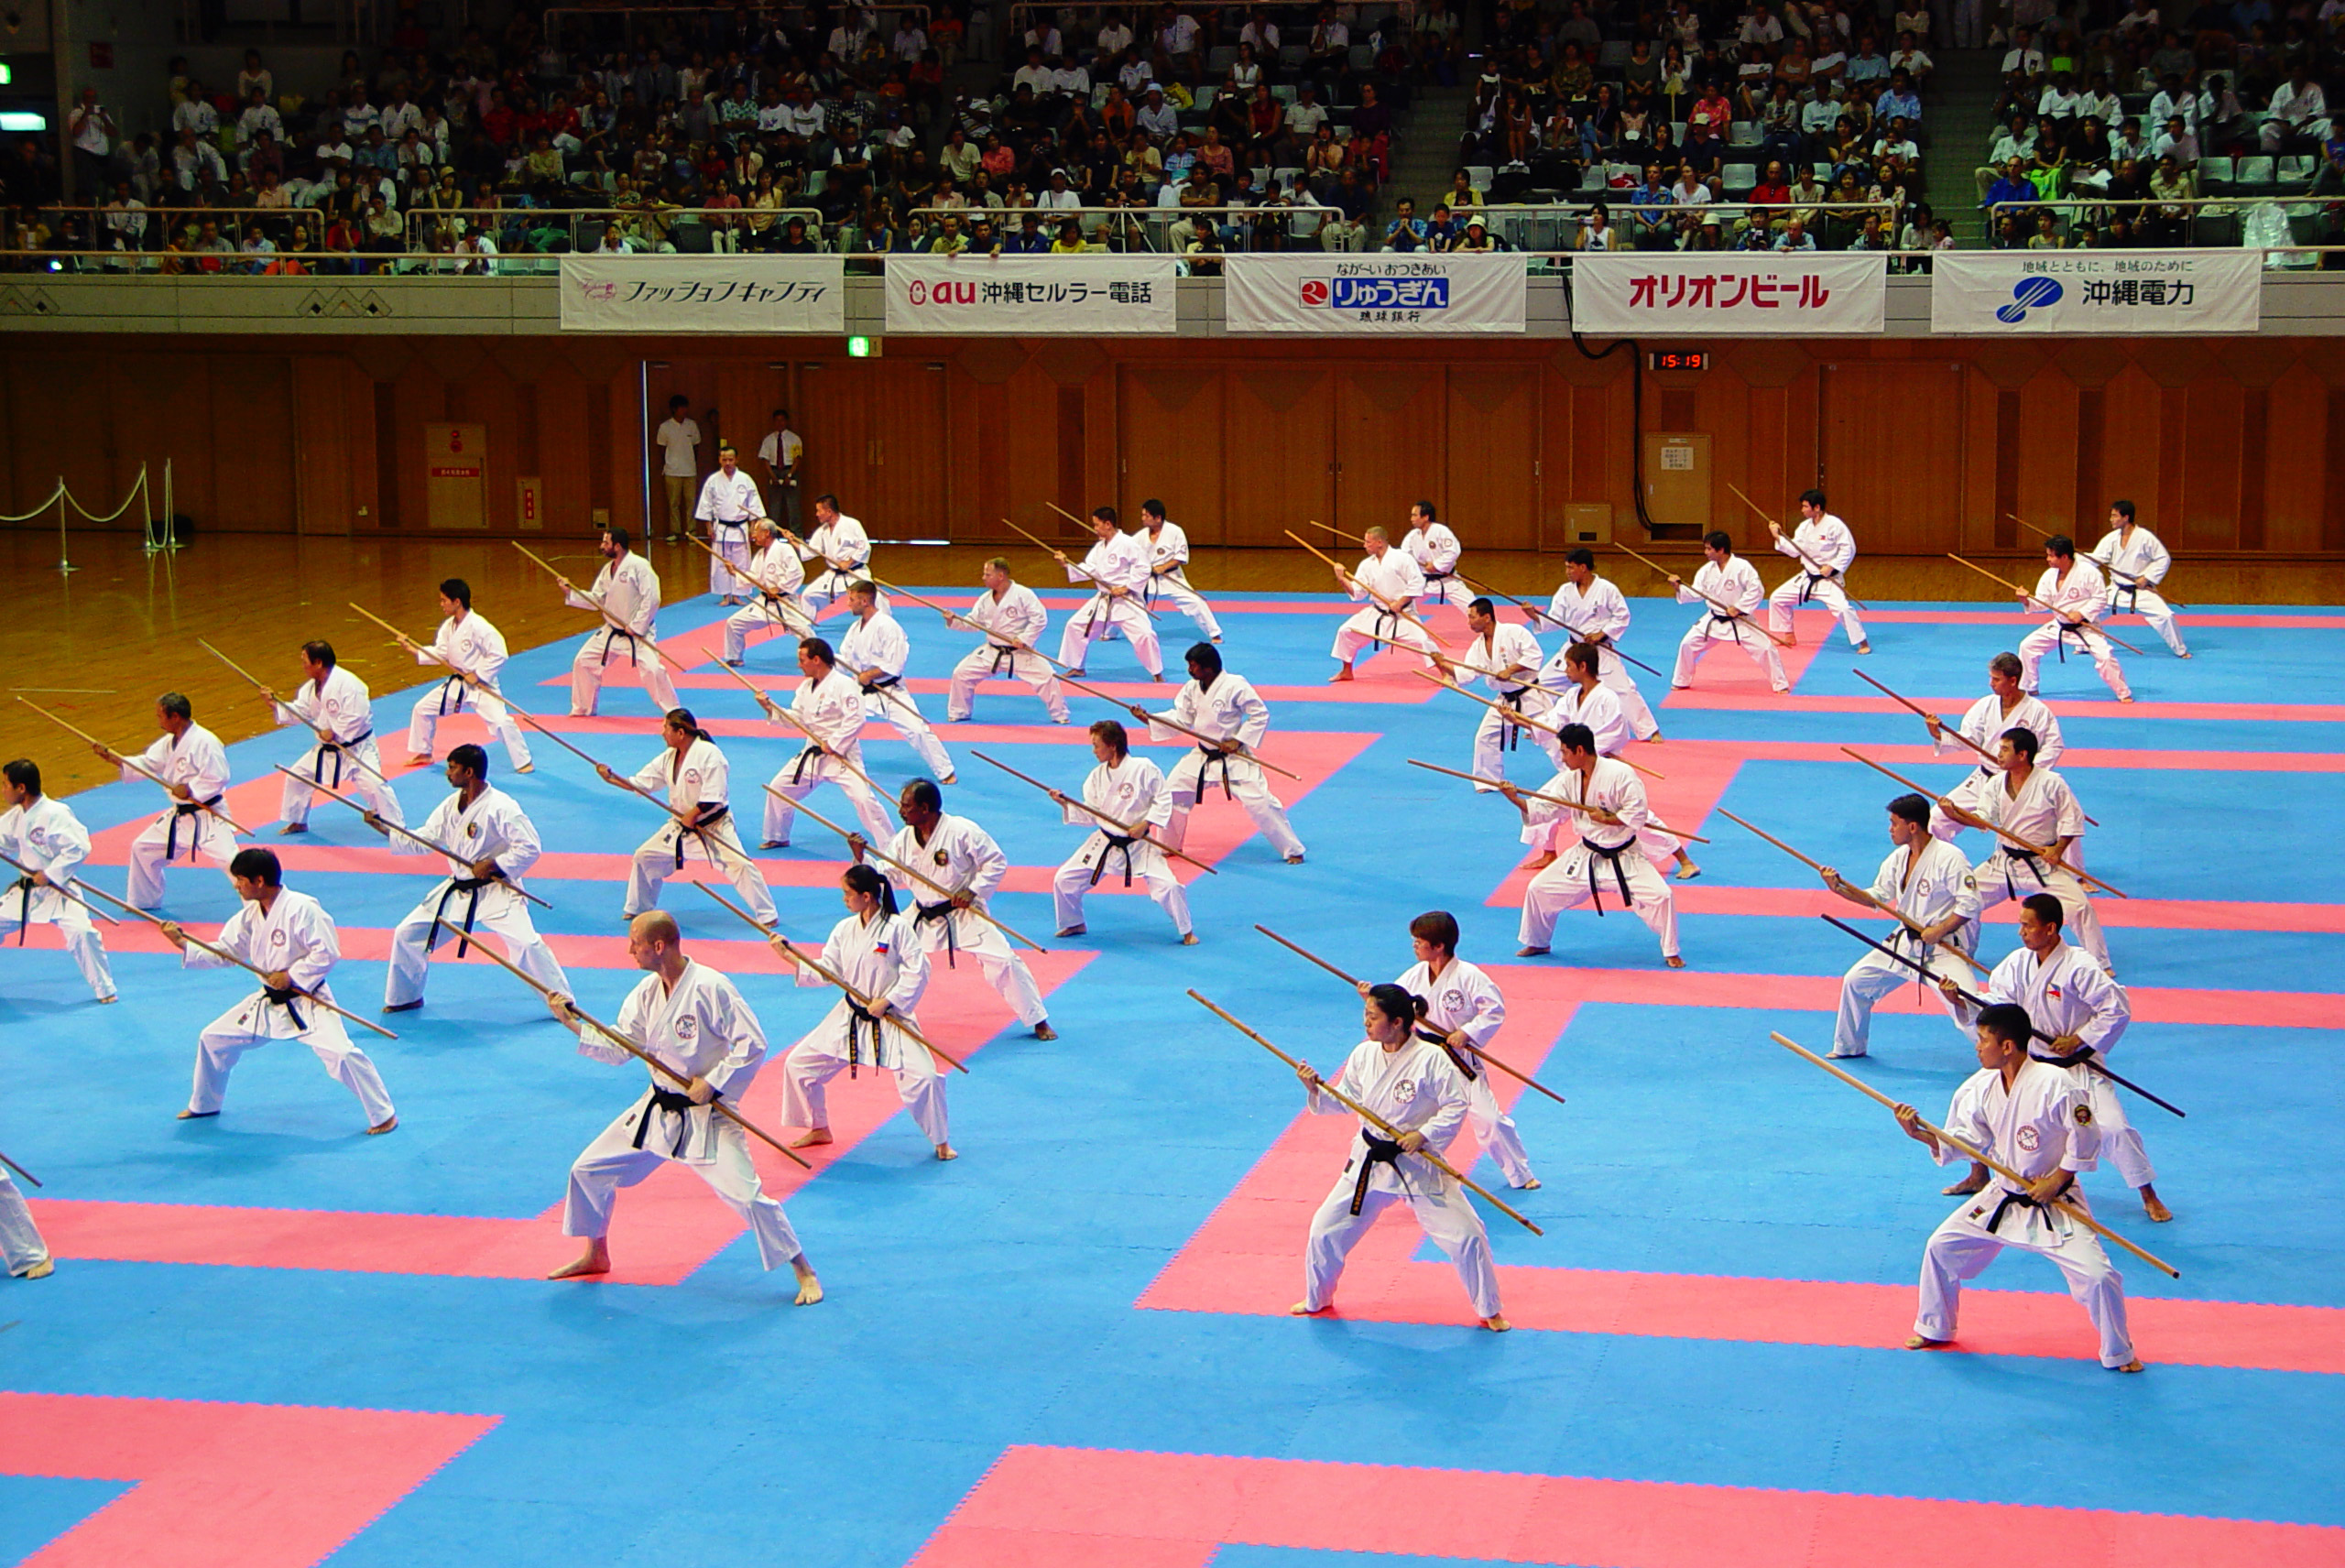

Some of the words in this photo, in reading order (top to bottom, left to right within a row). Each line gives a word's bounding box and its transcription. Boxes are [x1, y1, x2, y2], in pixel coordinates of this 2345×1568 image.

[1384, 263, 1446, 276] おつきあい
[2113, 260, 2194, 273] 地域のために
[933, 281, 976, 304] au
[982, 282, 1151, 304] 沖縄セルラー電話
[1336, 279, 1446, 306] りゅうぎん
[1630, 275, 1829, 308] オリオンビール
[2083, 279, 2194, 305] 沖縄電力
[1359, 310, 1421, 322] 琉球銀行
[1662, 354, 1701, 368] 15:19
